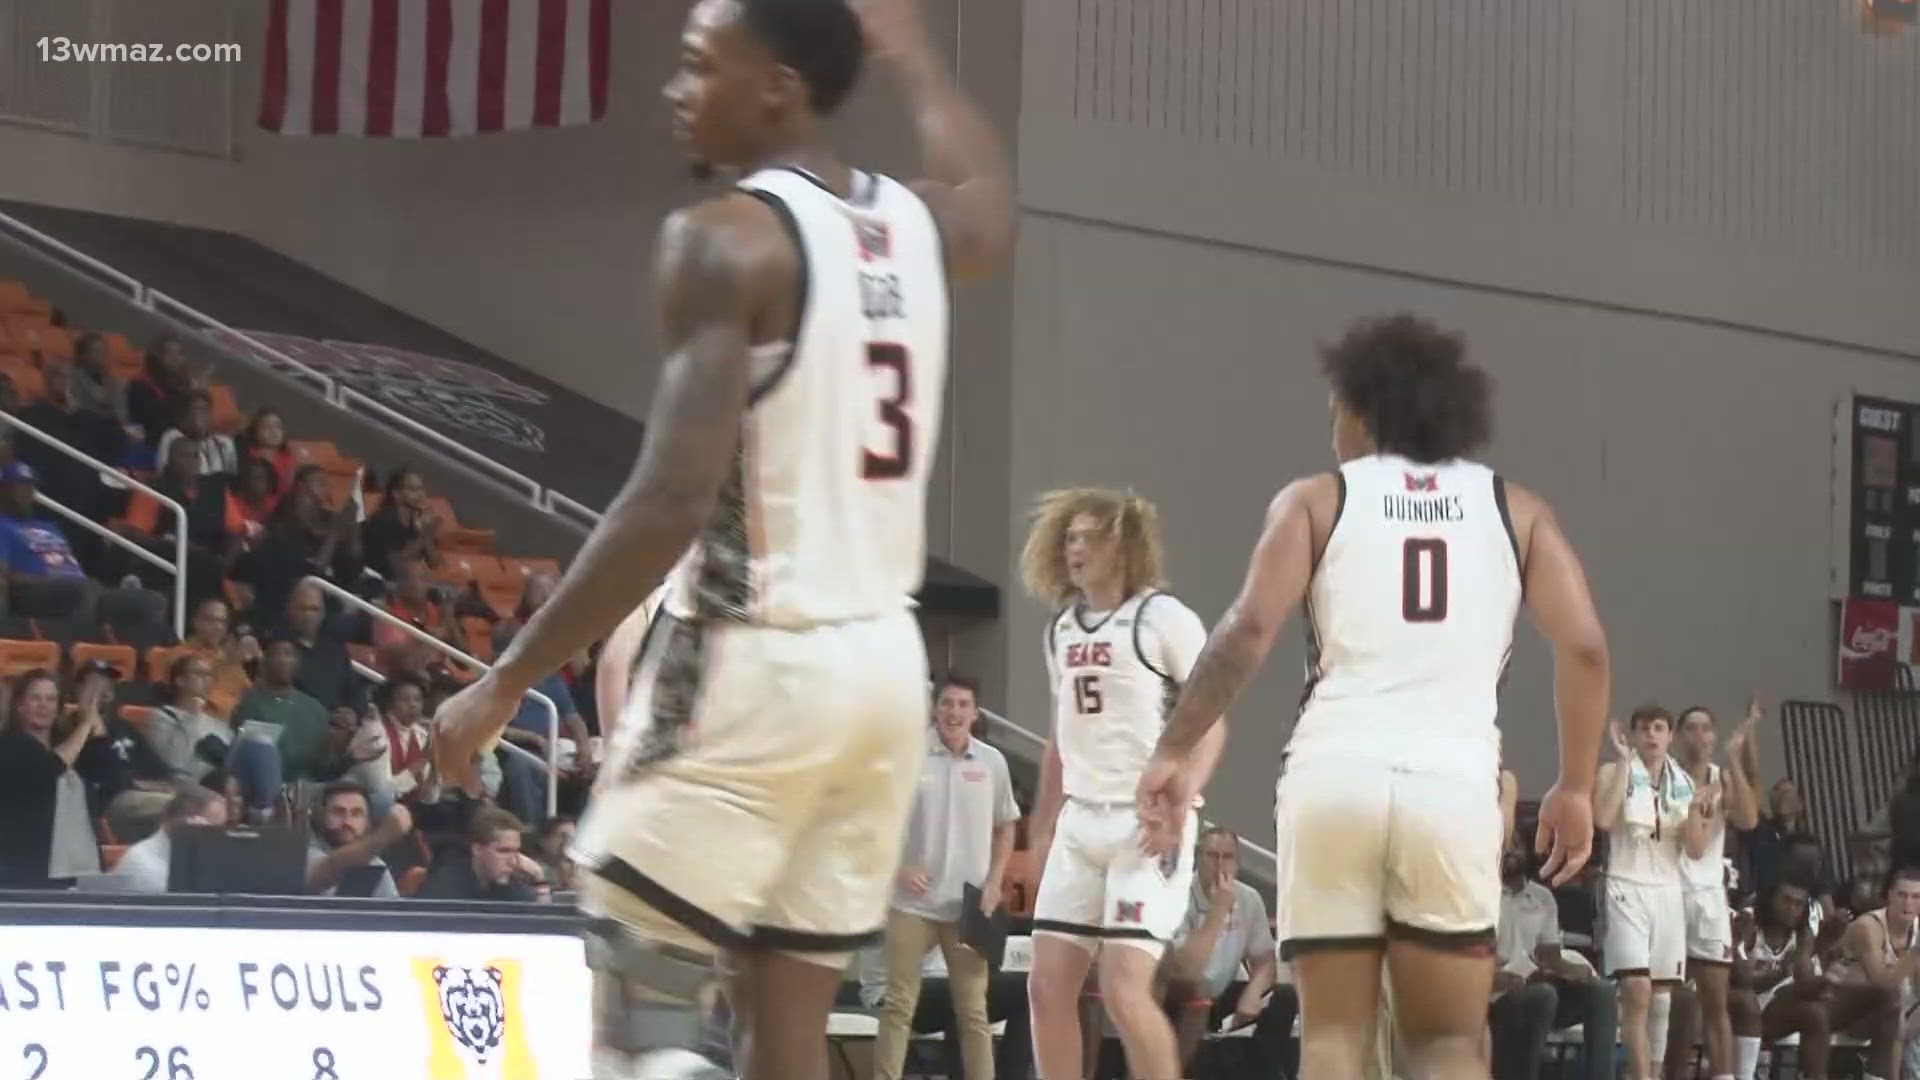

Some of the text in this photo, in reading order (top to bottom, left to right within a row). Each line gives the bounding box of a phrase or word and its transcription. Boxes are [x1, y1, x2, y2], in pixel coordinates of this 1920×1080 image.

[860, 341, 914, 479] 3
[1383, 494, 1464, 524] QUINONES
[1402, 537, 1448, 623] 0
[1074, 675, 1103, 714] 15
[99, 961, 211, 1012] FG%
[238, 962, 383, 1012] FOULS
[22, 1043, 340, 1080] 2 26 8
